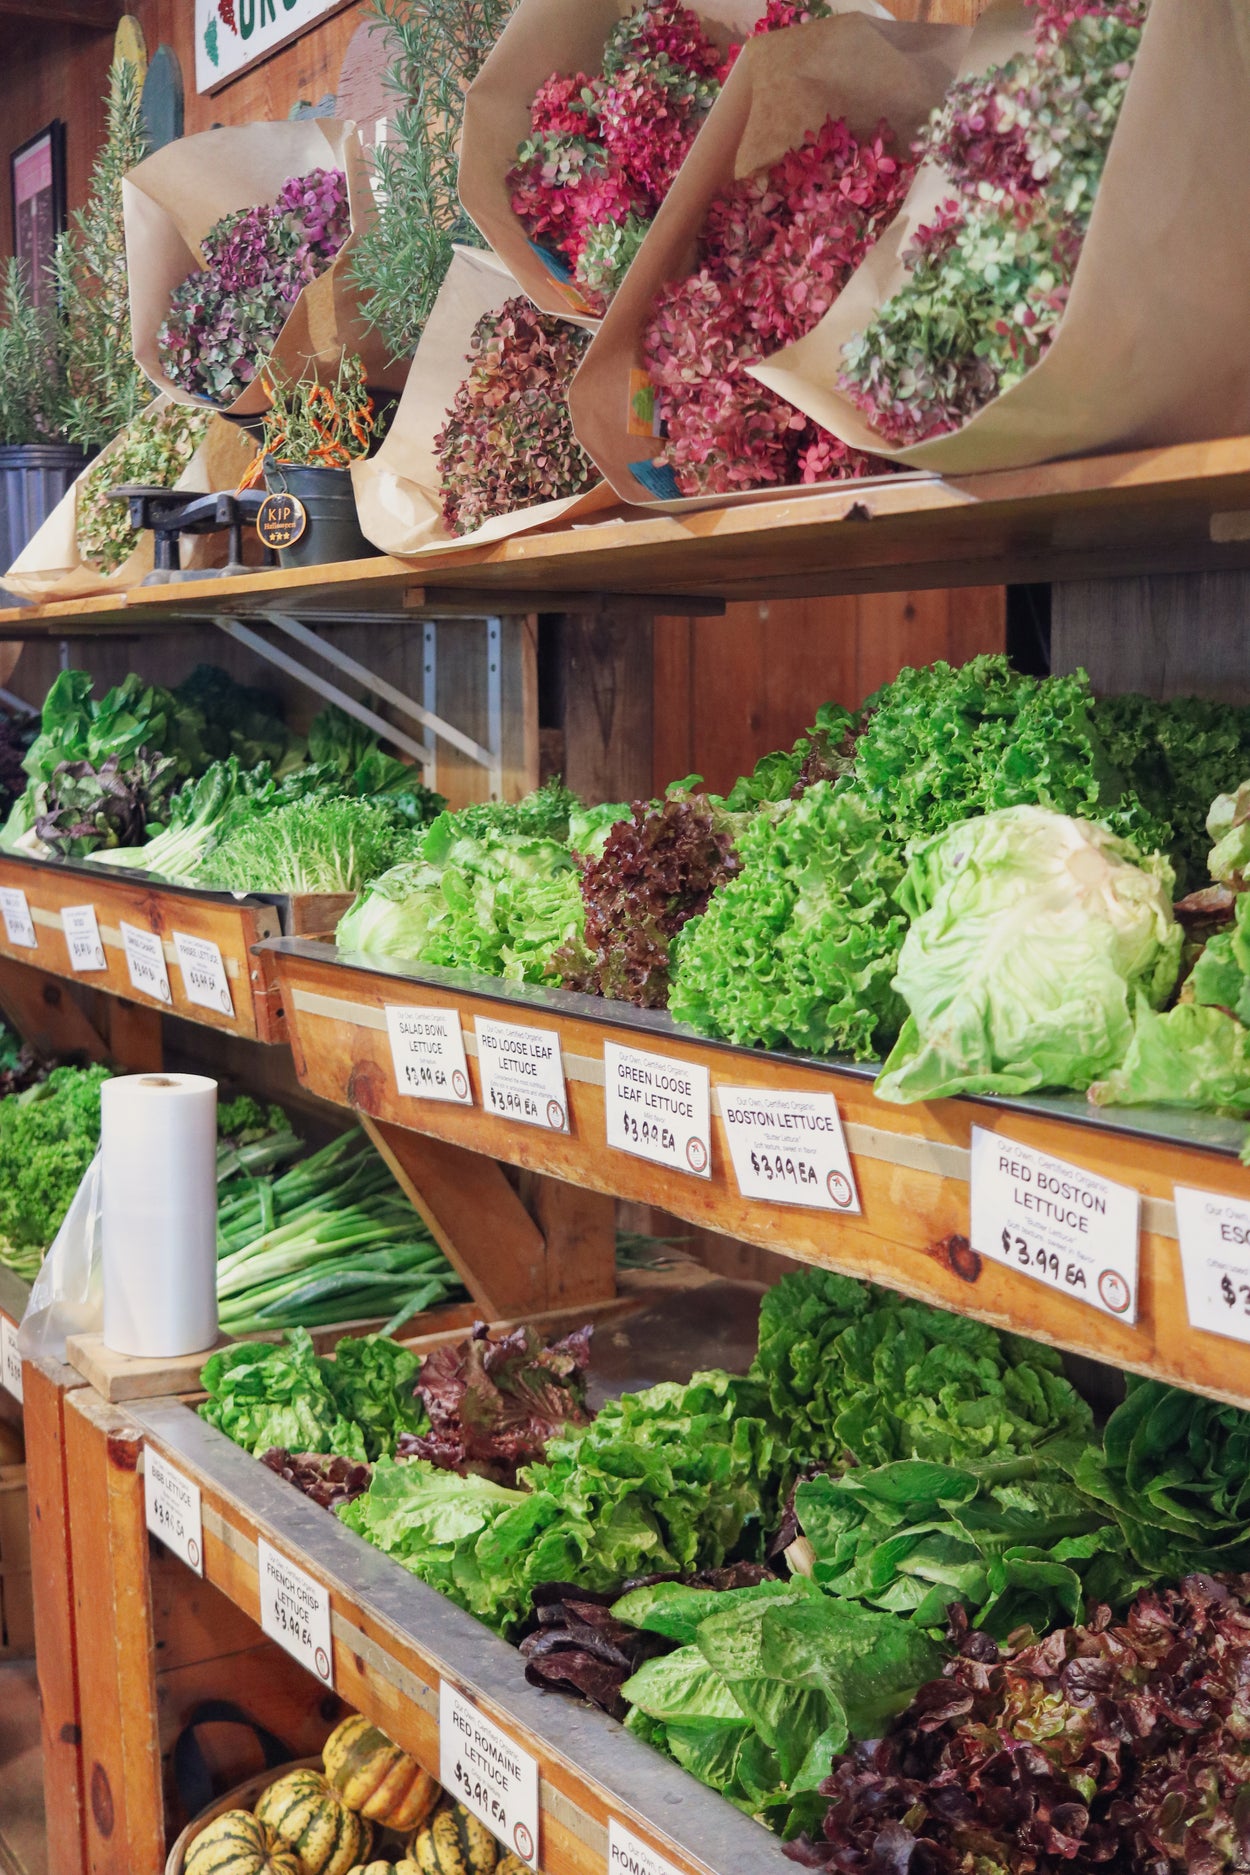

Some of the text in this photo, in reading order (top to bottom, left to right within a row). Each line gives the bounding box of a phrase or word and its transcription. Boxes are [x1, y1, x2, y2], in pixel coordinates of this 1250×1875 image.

[269, 508, 291, 521] KIP
[399, 1022, 447, 1037] SALAD BOWL
[409, 1041, 443, 1054] LETTUCE
[482, 1034, 553, 1060] RED LOOSE LEAF
[405, 1065, 447, 1086] $3.99 EA
[498, 1056, 538, 1076] LETTUCE
[617, 1064, 692, 1096] GREEN LOOSE
[490, 1087, 522, 1114] $3.99
[524, 1098, 538, 1117] EA
[617, 1084, 694, 1118] LEAF LETTUCE
[623, 1110, 676, 1152] $3.99 EA
[727, 1109, 835, 1132] BOSTON LETTUCE
[751, 1150, 818, 1185] $3.99 EA
[999, 1156, 1107, 1215] RED BOSTON
[1014, 1187, 1089, 1234] LETTUCE
[1001, 1227, 1087, 1289] $3.99 EA
[165, 1478, 192, 1508] LETTUCE
[266, 1563, 319, 1612] FRENCH CRISP
[277, 1588, 310, 1624] LETTUCE
[274, 1601, 313, 1648] $3.99 EA
[452, 1711, 522, 1782] RED ROMAINE
[464, 1742, 509, 1792] LETTUCE
[454, 1760, 506, 1829] $3.99 EA
